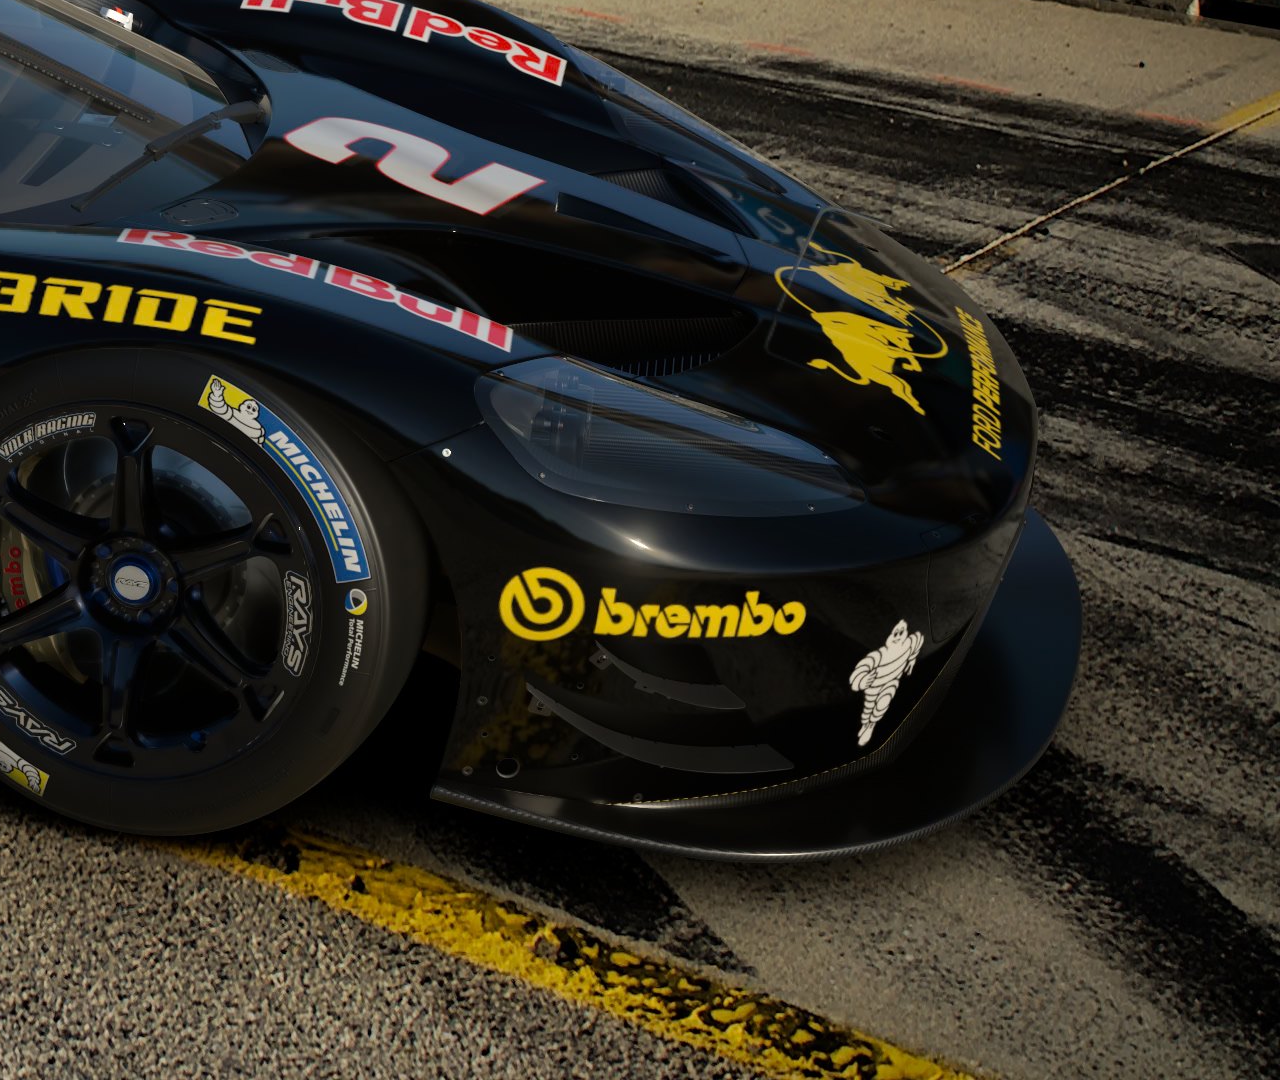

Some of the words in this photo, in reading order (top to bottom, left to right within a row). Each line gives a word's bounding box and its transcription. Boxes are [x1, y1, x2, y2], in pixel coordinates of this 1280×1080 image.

[284, 117, 547, 216] 2
[35, 412, 96, 440] RACING
[972, 403, 1002, 461] FORD
[268, 430, 361, 573] MICHELIN
[287, 575, 308, 673] RAYS
[348, 618, 356, 637] Total
[594, 587, 807, 639] brembo
[338, 637, 355, 687] Performance
[351, 619, 365, 671] MICHELIN
